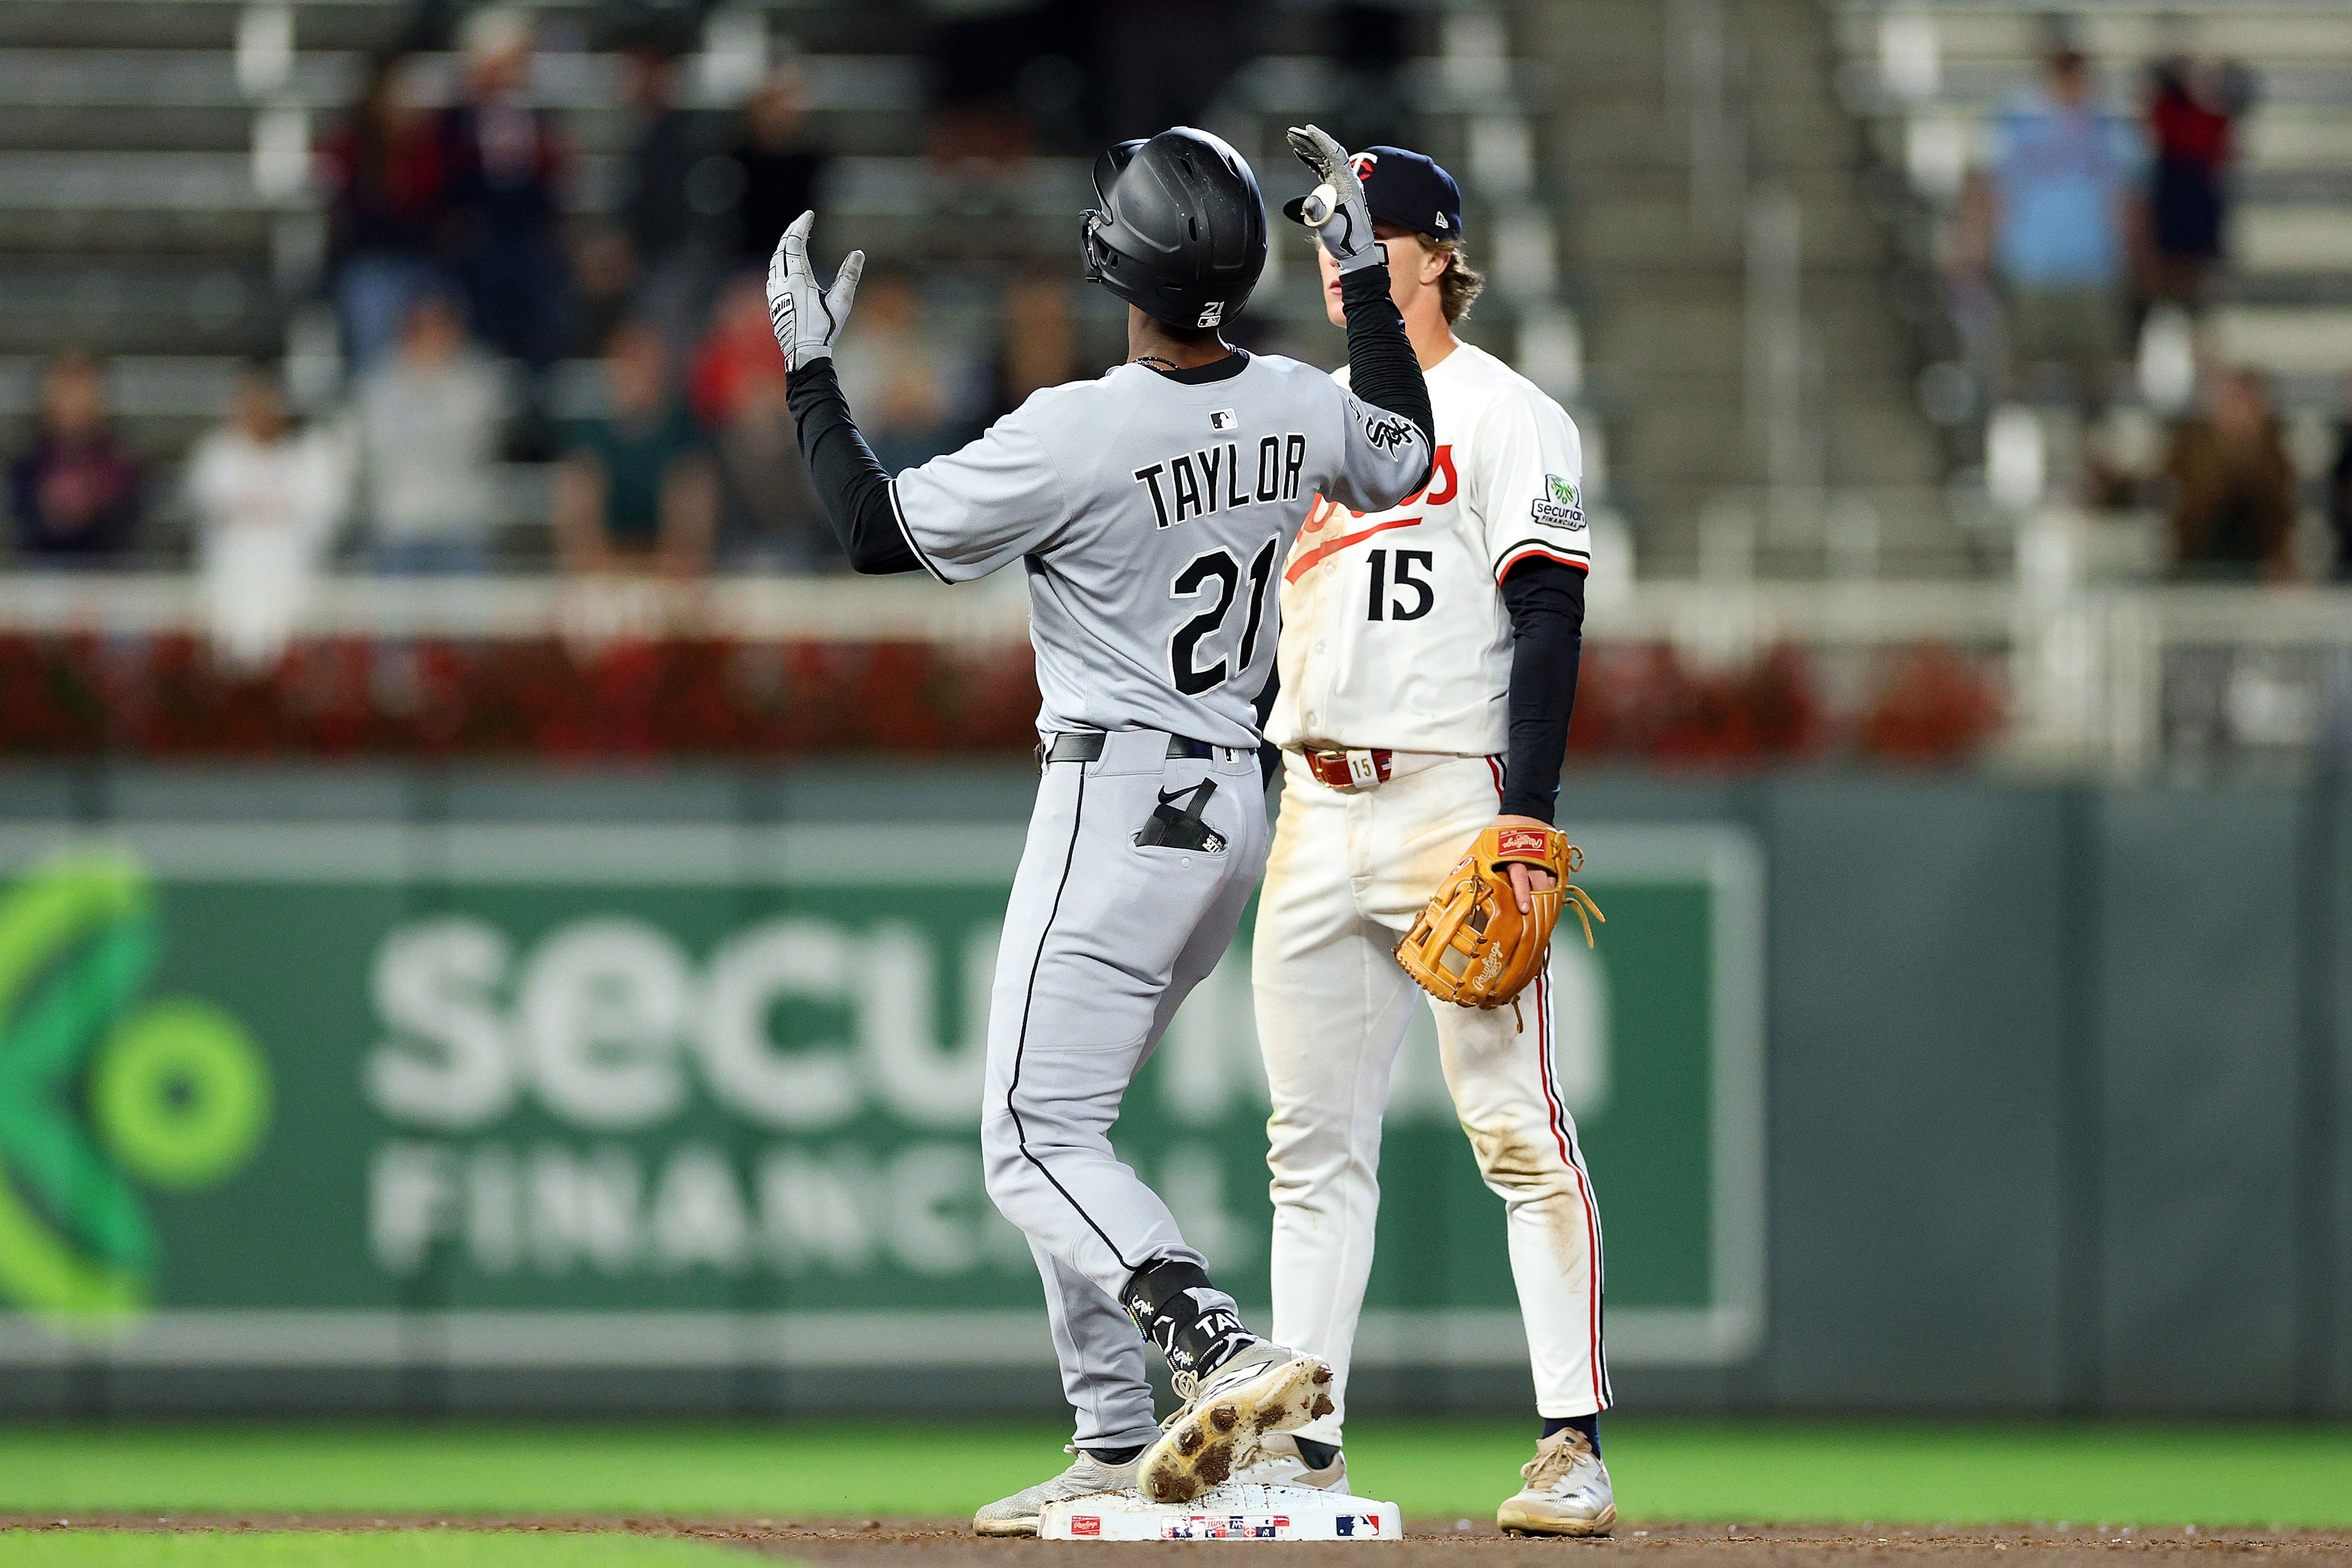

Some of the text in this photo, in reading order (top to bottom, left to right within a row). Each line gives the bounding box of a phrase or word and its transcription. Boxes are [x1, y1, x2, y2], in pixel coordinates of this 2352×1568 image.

[1200, 301, 1224, 316] 21
[1131, 432, 1307, 530] TAYLOR
[1537, 503, 1584, 522] securian
[1541, 515, 1577, 528] FINANCIAL
[1366, 549, 1434, 620] 15
[1167, 532, 1280, 699] 21
[1352, 758, 1371, 778] 15
[1502, 835, 1542, 849] Rawlings
[1473, 941, 1503, 991] Rawlings
[1074, 1520, 1098, 1530] Rawlings
